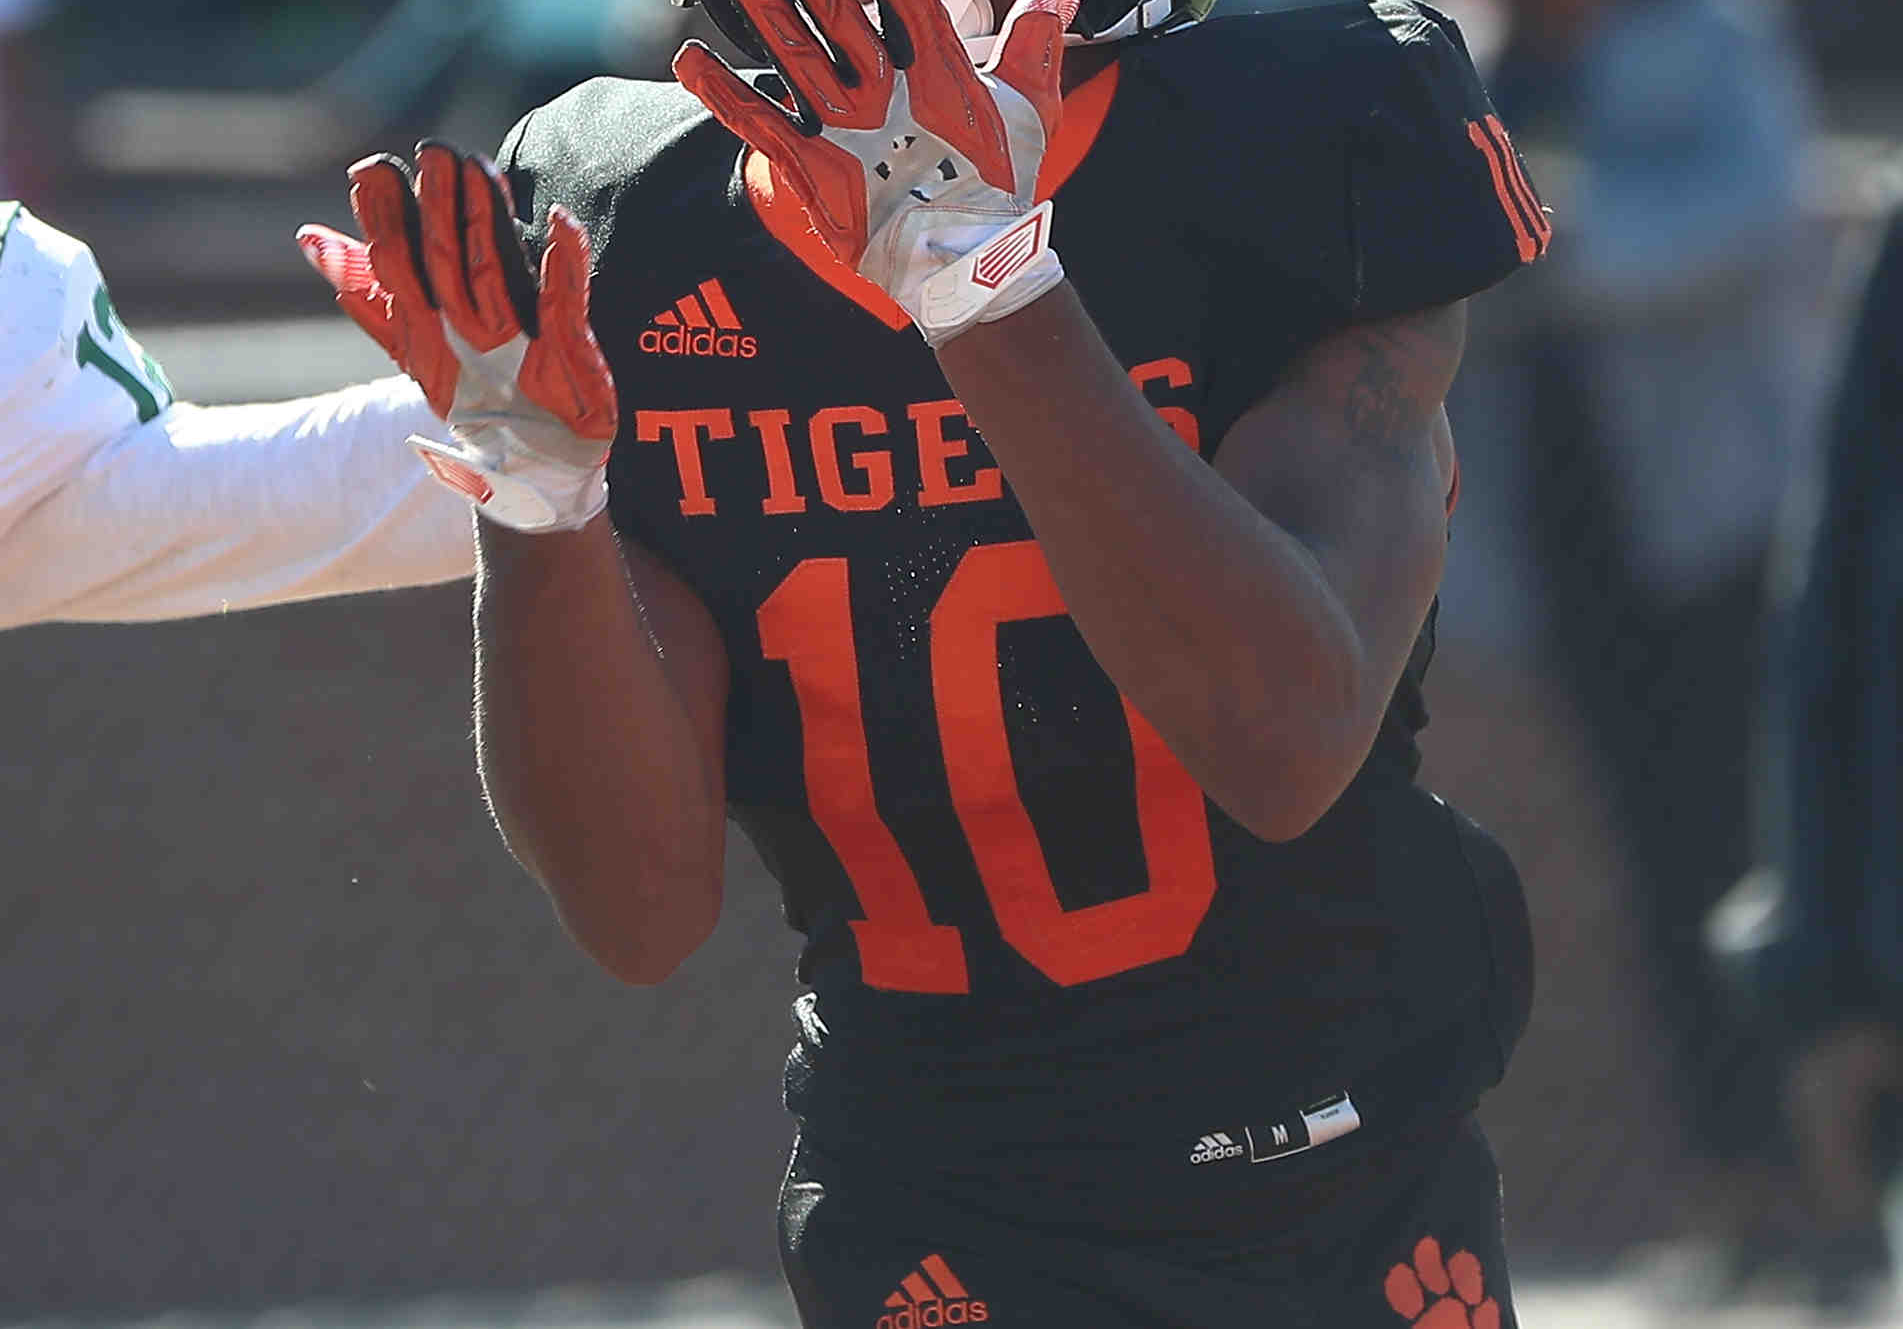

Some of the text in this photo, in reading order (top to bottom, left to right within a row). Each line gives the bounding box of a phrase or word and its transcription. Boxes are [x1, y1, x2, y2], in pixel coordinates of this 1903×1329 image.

[638, 324, 758, 359] adidas
[634, 356, 1201, 516] TIGES
[755, 538, 1218, 995] 10
[1271, 1123, 1289, 1147] M
[1189, 1144, 1244, 1165] adidas
[873, 1297, 990, 1329] adidas
